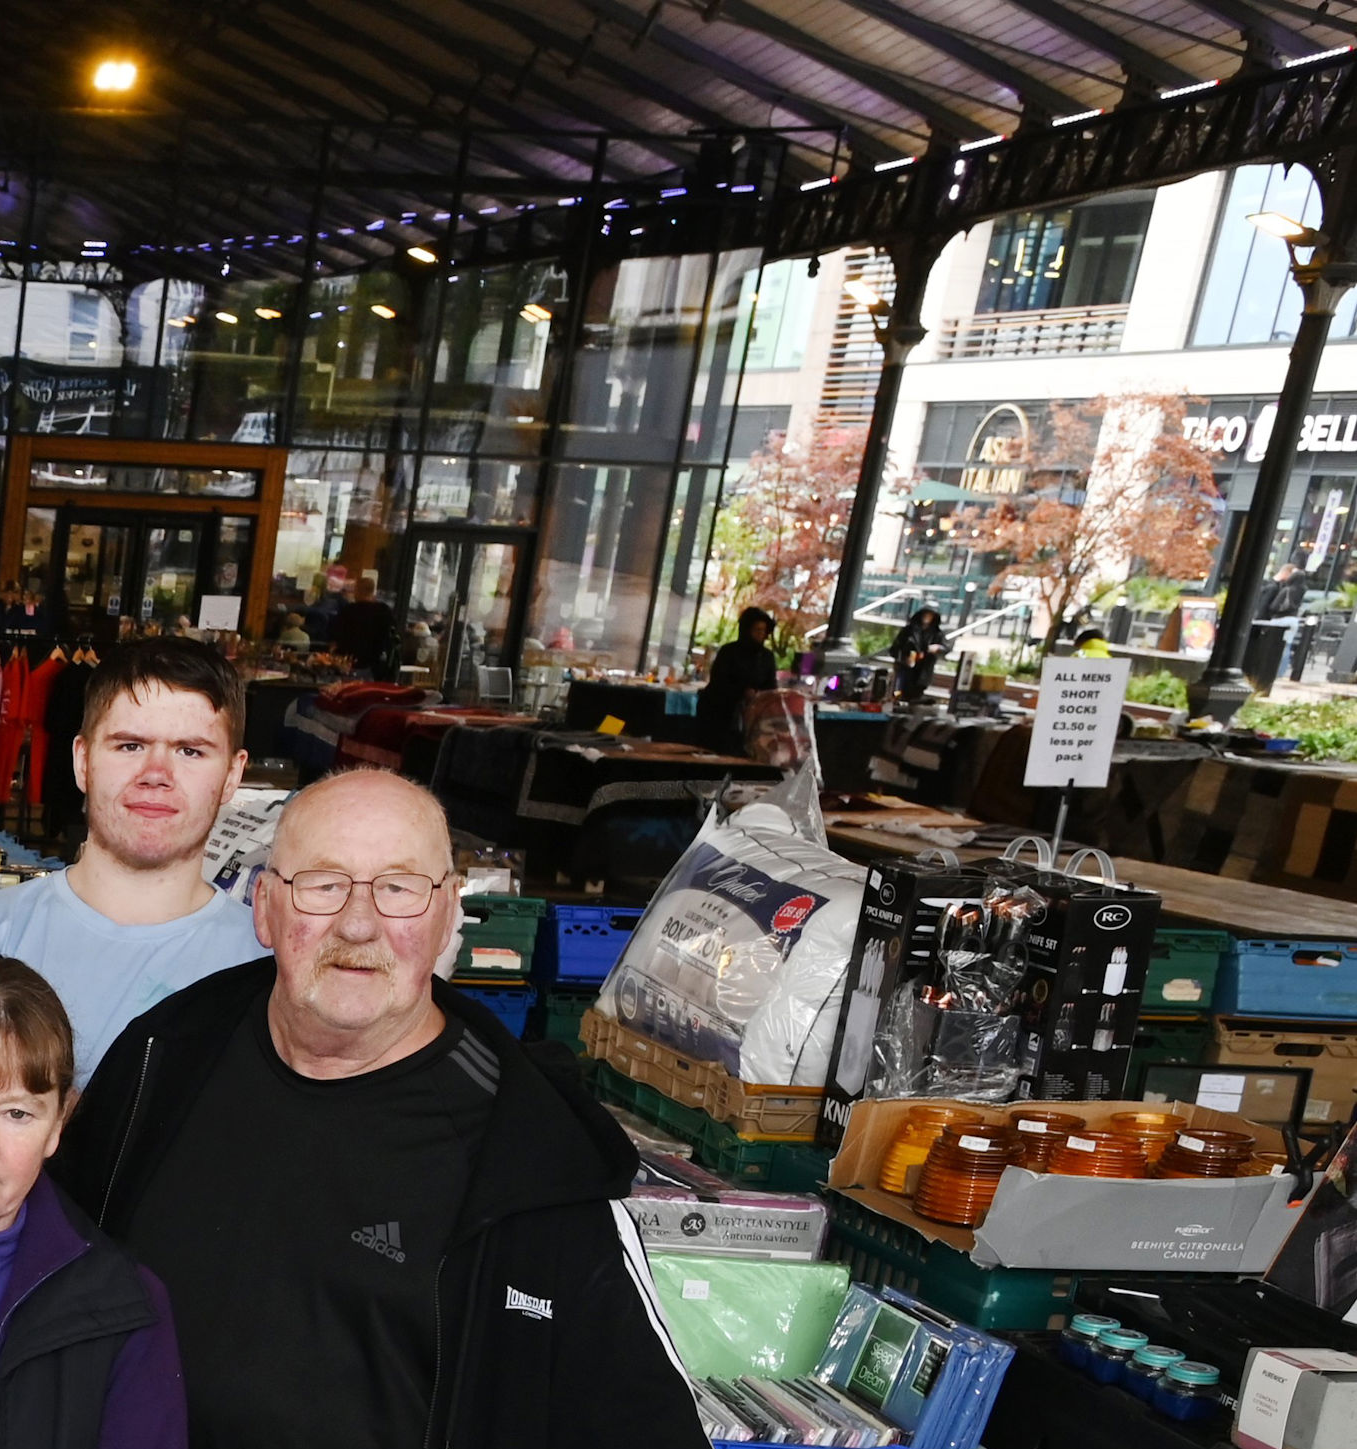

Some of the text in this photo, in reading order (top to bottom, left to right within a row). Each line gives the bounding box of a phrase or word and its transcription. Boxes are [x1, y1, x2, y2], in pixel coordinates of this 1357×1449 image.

[1182, 415, 1357, 452] TACO BELL
[959, 468, 1021, 495] ITALIAN
[1055, 673, 1112, 683] ALL MENS
[1061, 690, 1101, 699] SHORT
[1058, 705, 1098, 714] SOCKS
[1052, 722, 1085, 731] £3.50
[1050, 738, 1093, 748] less per
[1055, 753, 1083, 762] pack
[1102, 912, 1124, 922] RC
[661, 916, 684, 942] BOX
[1029, 934, 1058, 951] NIFE SET
[824, 1097, 849, 1127] KNI
[715, 1217, 811, 1231] EGYPTIAN STYLE
[722, 1230, 799, 1244] Antonio saviero
[351, 1230, 406, 1263] adidas
[1131, 1241, 1244, 1251] BEEHIVE CITRONELLA
[1163, 1251, 1207, 1260] CANDLE
[505, 1285, 553, 1316] LONSDAL
[858, 1365, 886, 1391] Dream
[1221, 1393, 1238, 1411] IFE
